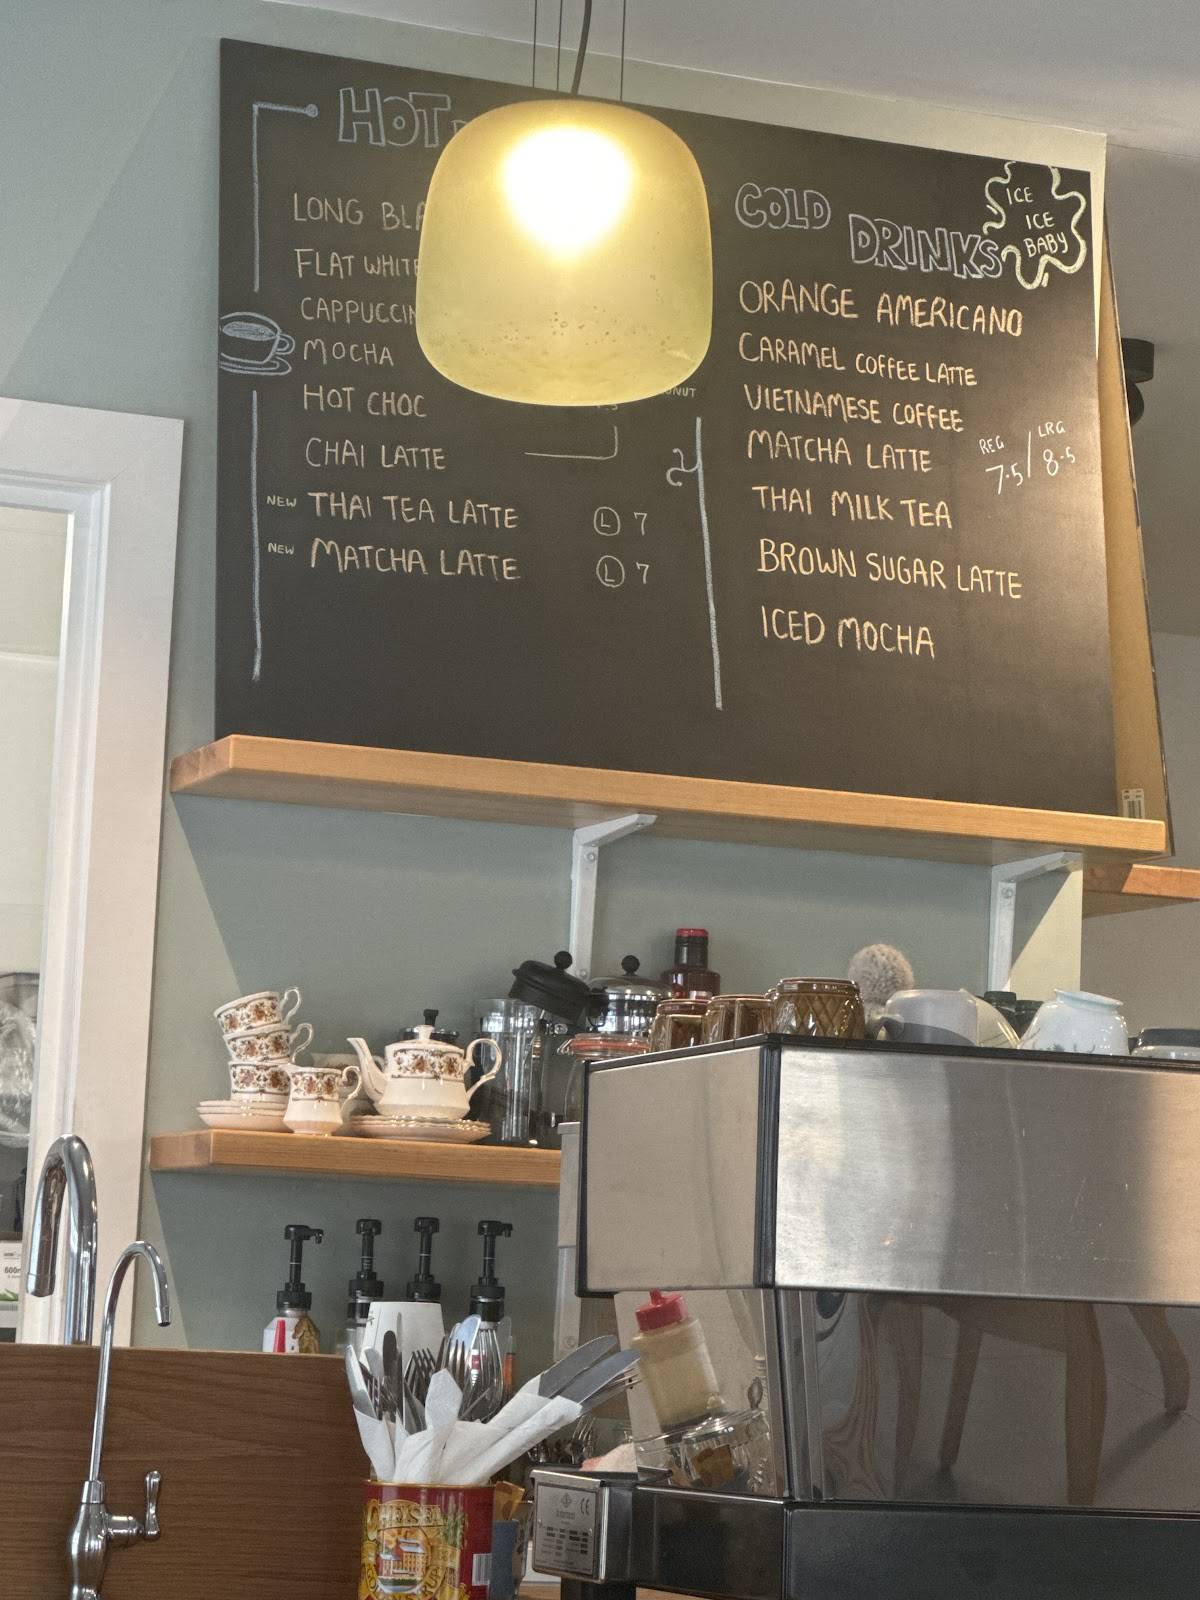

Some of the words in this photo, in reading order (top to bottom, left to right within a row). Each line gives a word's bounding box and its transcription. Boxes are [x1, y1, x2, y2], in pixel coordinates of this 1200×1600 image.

[338, 87, 450, 148] HOT
[294, 193, 363, 224] LONG
[382, 201, 425, 231] BLA
[1006, 187, 1033, 205] ICE
[735, 183, 831, 229] COLD
[849, 213, 1002, 279] DRINKS
[1026, 212, 1054, 229] ICE
[294, 249, 354, 279] FLAT
[1024, 232, 1068, 257] BABY
[301, 297, 416, 325] CAPPUCCIN
[740, 279, 858, 318] ORANGE
[877, 293, 1022, 336] AMERICANO
[304, 339, 394, 366] MOCHA
[739, 332, 845, 370] CARAMEL
[856, 353, 920, 381] COFFEE
[926, 363, 977, 386] LATTE
[304, 384, 354, 411] HOT
[367, 392, 426, 417] CHOC
[744, 384, 881, 424] VIETNAMESE
[893, 403, 963, 432] COFFEE
[306, 438, 364, 467] CHAI
[382, 445, 445, 469] LATTE
[748, 430, 852, 465] MATCHA
[867, 444, 932, 472] LATTE
[979, 436, 1004, 454] REG
[1038, 421, 1065, 437] LRG
[267, 495, 296, 507] NEW
[308, 492, 371, 520] THAI
[382, 496, 434, 522] TEA
[449, 500, 518, 528] LATTE
[634, 512, 647, 535] 7
[752, 486, 811, 514] THAI
[832, 491, 893, 521] MILK
[900, 499, 952, 528] TEA
[268, 543, 294, 555] NEW
[311, 538, 428, 574] MATCHA
[440, 550, 520, 580] LATTE
[636, 562, 649, 584] 7
[757, 539, 856, 577] BROWN
[866, 553, 946, 589] SUGAR
[958, 565, 1021, 598] LATTE
[762, 606, 825, 645] ICED
[838, 617, 934, 659] MOCHA
